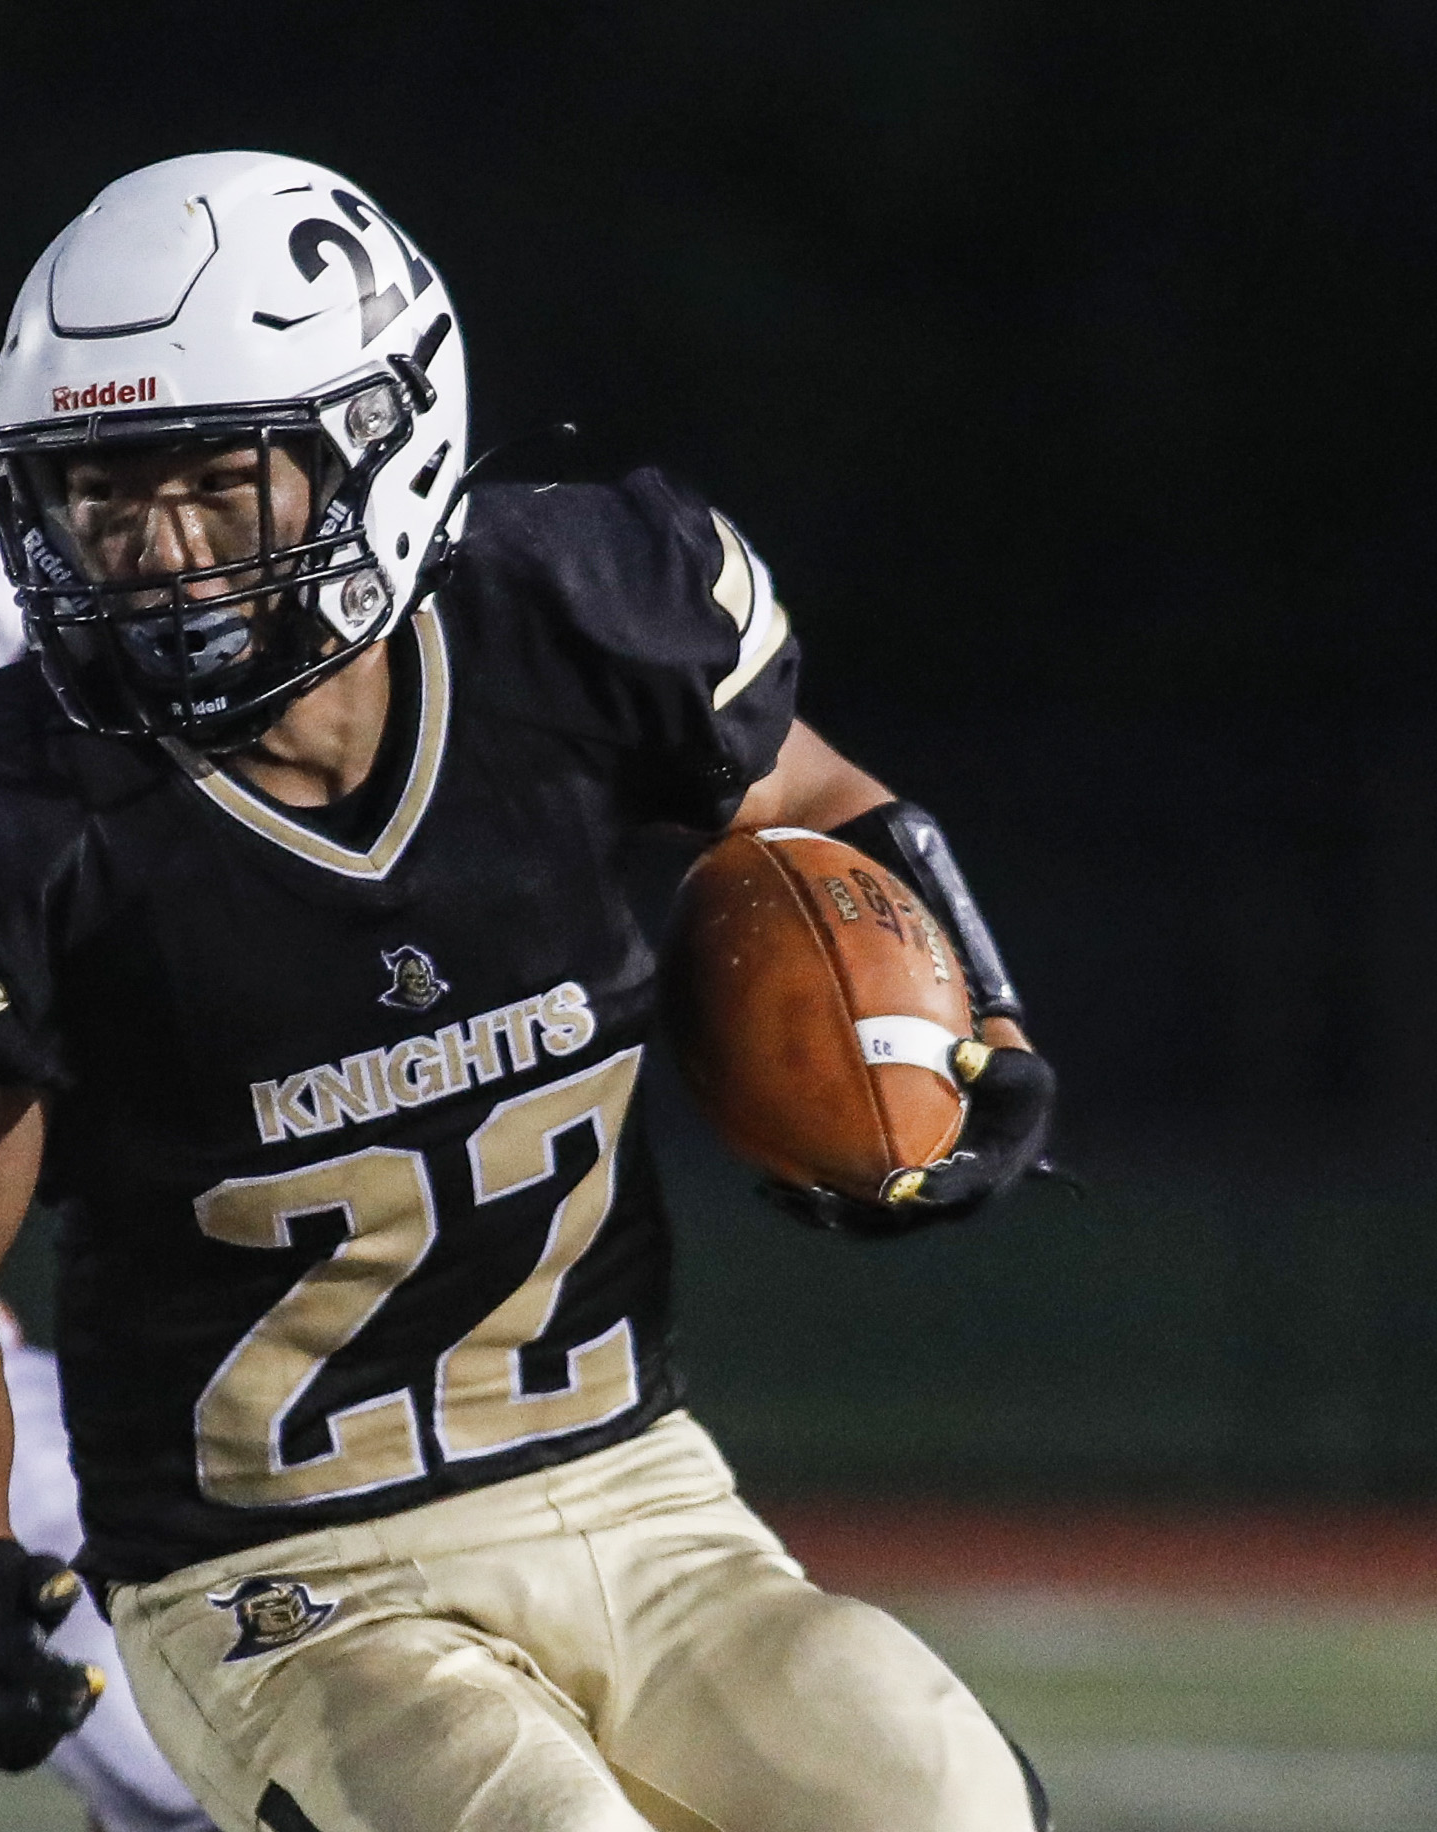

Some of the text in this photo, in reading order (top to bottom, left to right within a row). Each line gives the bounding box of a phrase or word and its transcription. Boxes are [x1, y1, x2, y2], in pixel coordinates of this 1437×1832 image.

[288, 188, 434, 350] 22
[52, 376, 157, 412] Riddell
[251, 981, 595, 1144] KNIGHTS
[193, 1045, 645, 1508] 22
